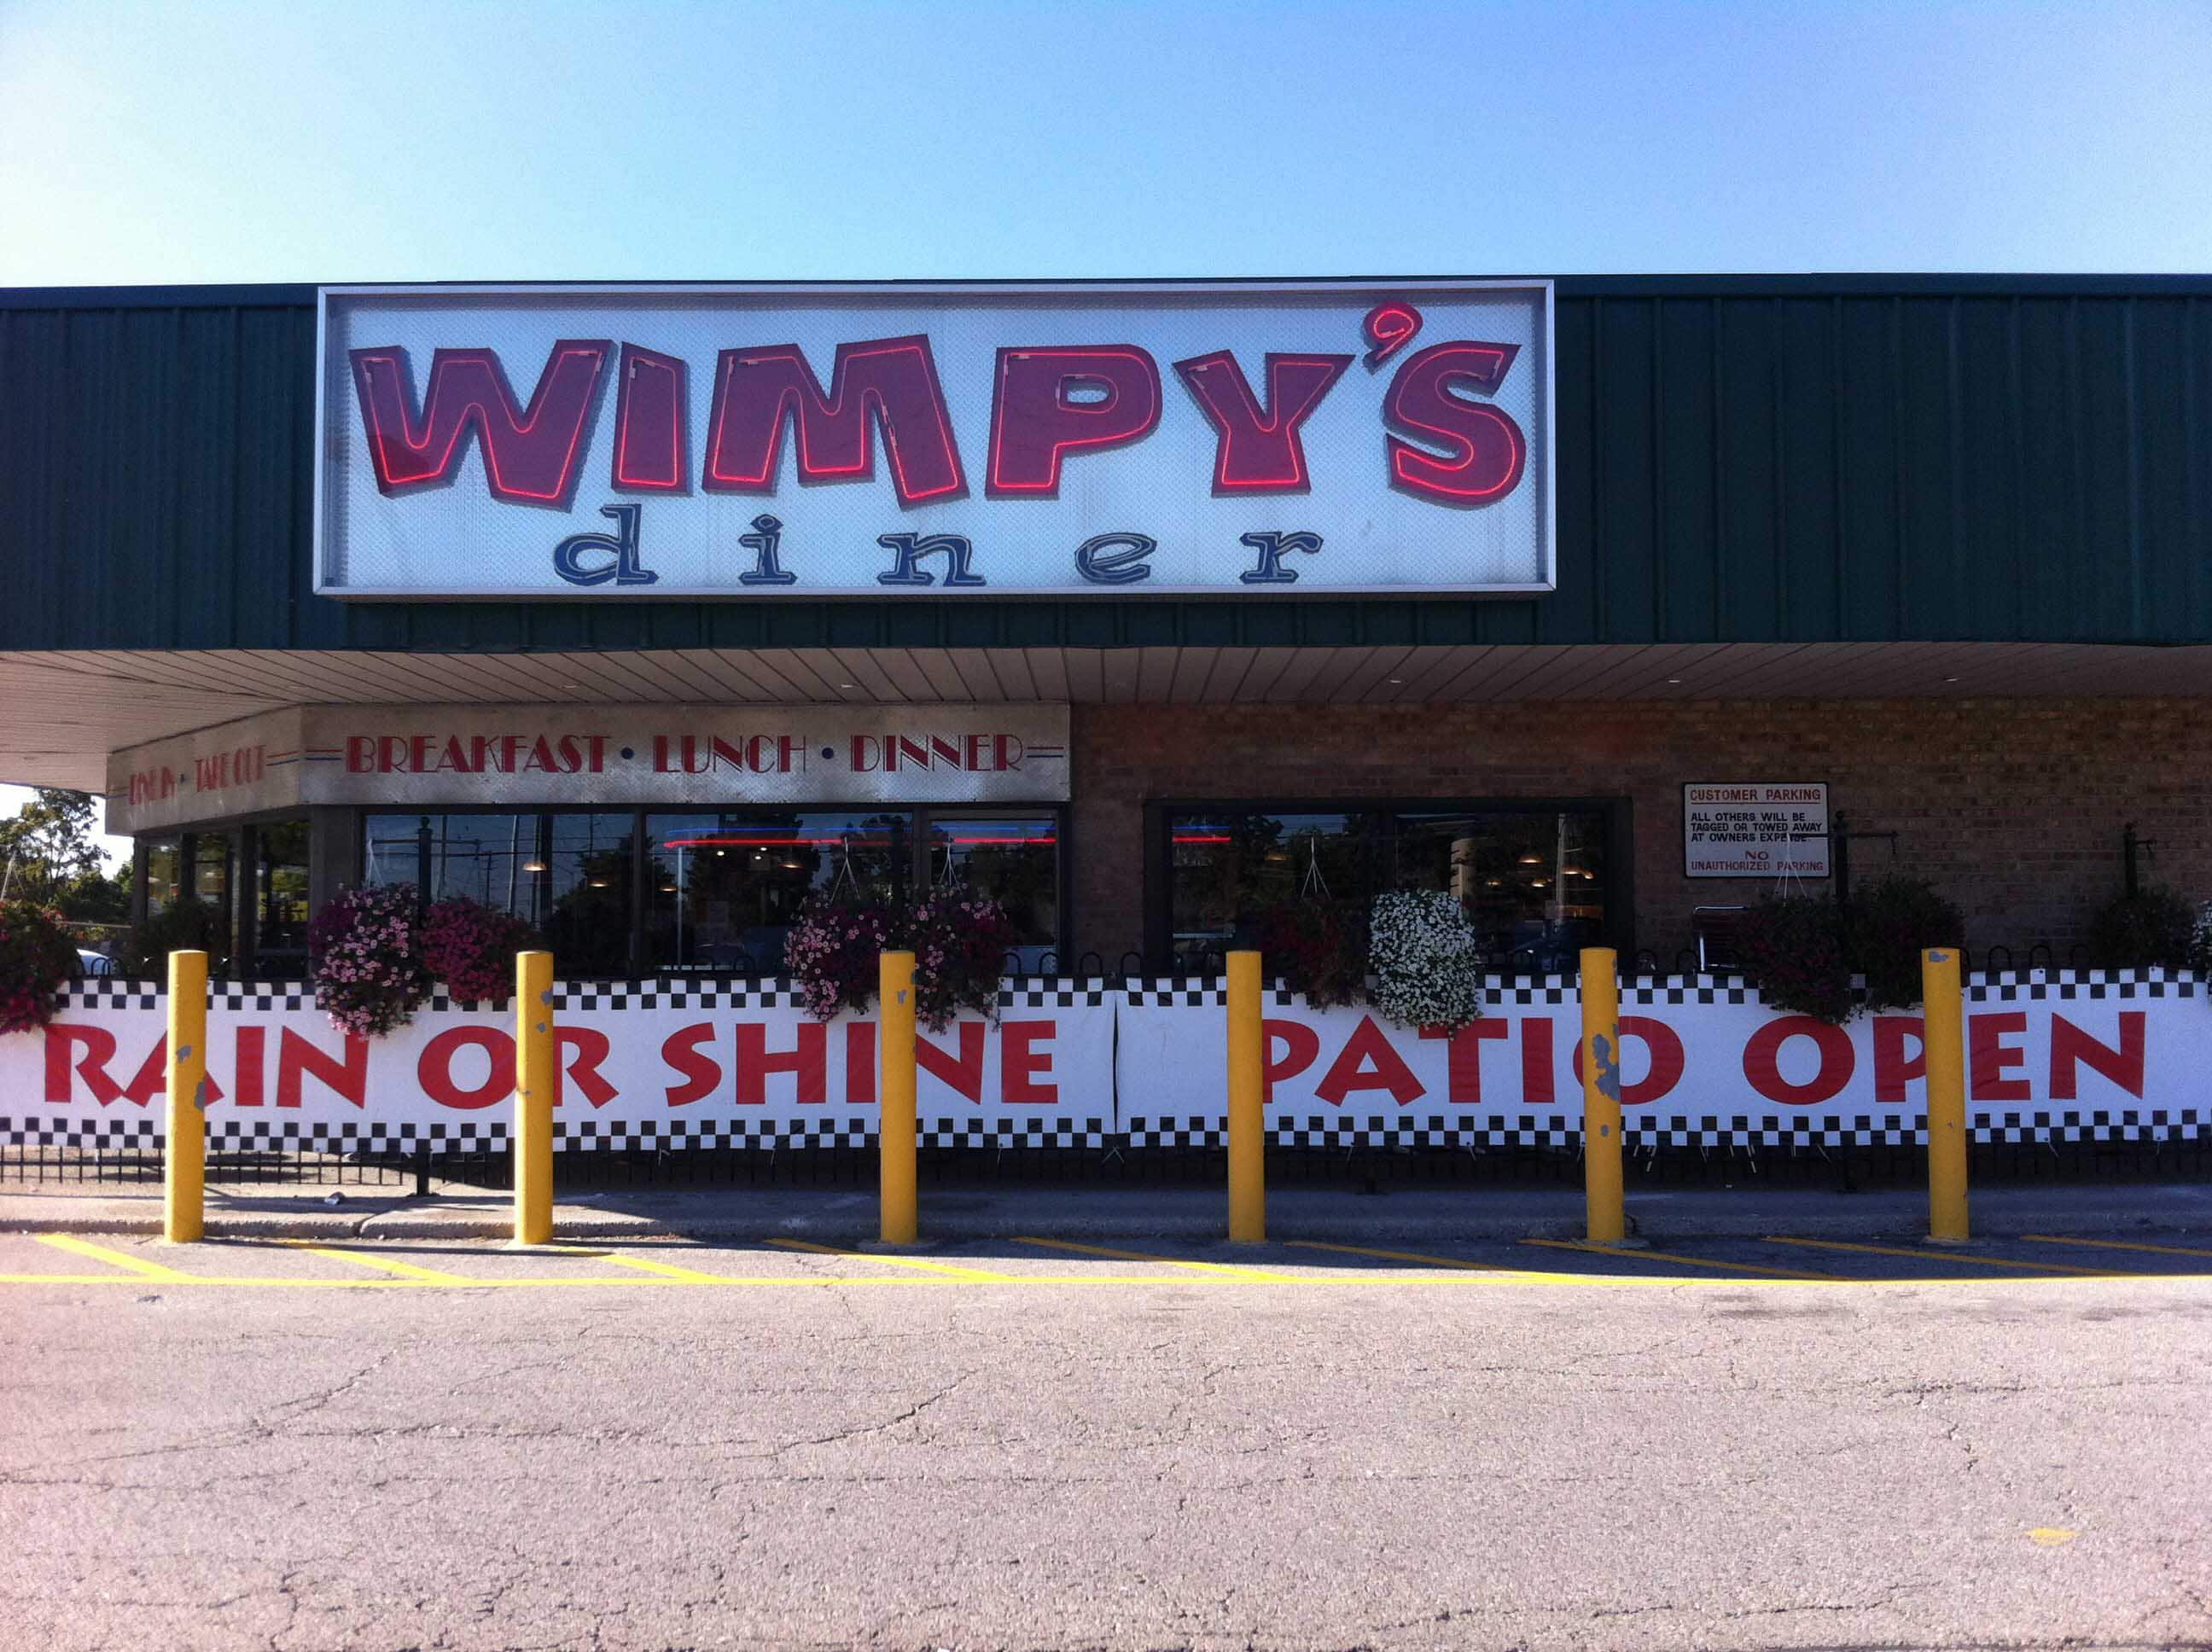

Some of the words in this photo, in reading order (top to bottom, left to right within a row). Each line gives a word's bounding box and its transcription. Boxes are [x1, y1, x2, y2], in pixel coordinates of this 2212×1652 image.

[349, 301, 1527, 512] WIMPY'S
[553, 503, 1323, 586] diner
[346, 736, 611, 773] BREAKFAST
[654, 736, 806, 773] LUNCH
[851, 735, 1023, 772] DINNER
[1691, 789, 1757, 800] CUSTOMER
[1767, 789, 1820, 800] PARKING
[1691, 812, 1710, 822] ALL
[1715, 812, 1755, 822] OTHERS
[1761, 812, 1787, 822] WILL
[1793, 812, 1805, 822] BE
[1691, 823, 1729, 832] TAGGED
[1734, 823, 1748, 832] OR
[1753, 823, 1788, 832] TOWED
[1792, 823, 1822, 832] AWAY
[1691, 833, 1704, 842] AT
[1709, 833, 1755, 842] OWNERS
[1745, 851, 1769, 860] NO
[1691, 861, 1770, 870] UNAUTHORIZED
[1778, 861, 1824, 870] PARKING
[44, 1024, 369, 1108] RAIN
[417, 1025, 619, 1108] OR
[661, 1021, 1058, 1107] SHINE
[1262, 1014, 1685, 1106] PATIO
[1743, 1010, 2146, 1105] OPEN
